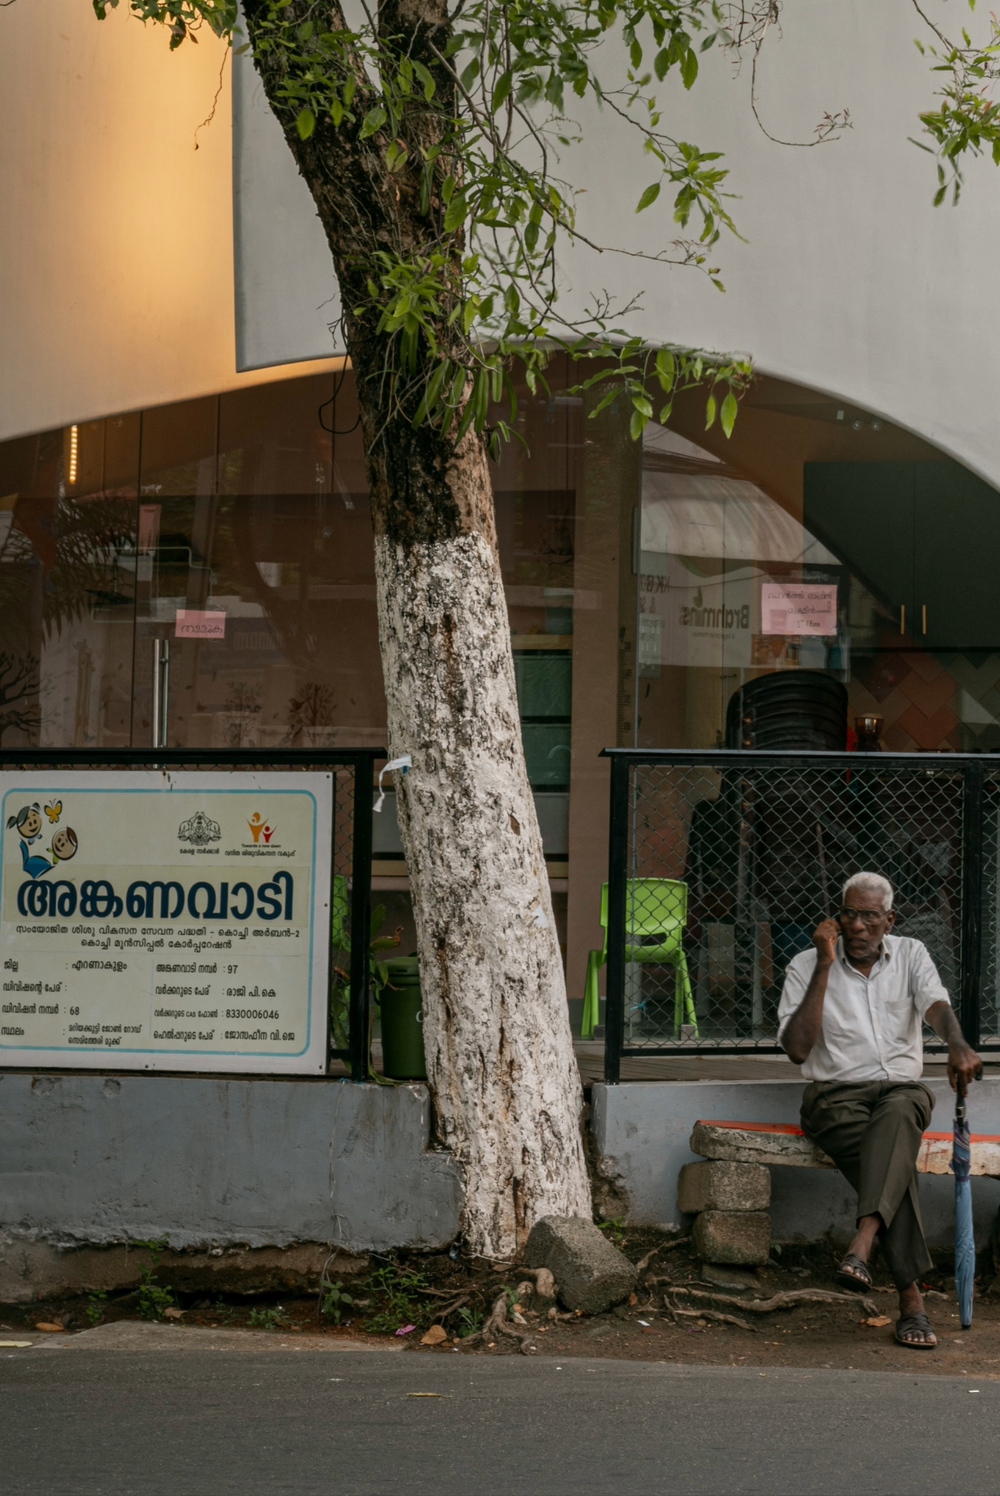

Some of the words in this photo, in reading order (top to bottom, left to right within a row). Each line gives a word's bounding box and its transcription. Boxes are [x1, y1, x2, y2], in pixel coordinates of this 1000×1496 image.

[17, 870, 294, 921] അങ്കണവാടി
[16, 924, 68, 933] സംയോജിത
[72, 925, 95, 937] ശിശു
[99, 925, 137, 934] വികസന
[178, 927, 206, 935] പദ്ധതി
[218, 927, 248, 939] കൊച്ചി
[81, 938, 111, 950] കൊച്ചി
[115, 938, 164, 952] മുൻസിപ്പൽ
[168, 939, 232, 953] കോർപ്പറേഷൻ
[4, 959, 18, 972] ജില്ല
[72, 960, 127, 972] എറണാകുളം
[156, 962, 196, 973] അങ്കണവാടി
[198, 963, 217, 973] നമ്പർ
[228, 965, 238, 974] 97
[227, 986, 246, 996] രാജി
[39, 1004, 59, 1014] നമ്പർ
[70, 1007, 79, 1015] 68
[226, 1009, 279, 1019] 8330006046
[1, 1027, 24, 1035] സ്ഥലം
